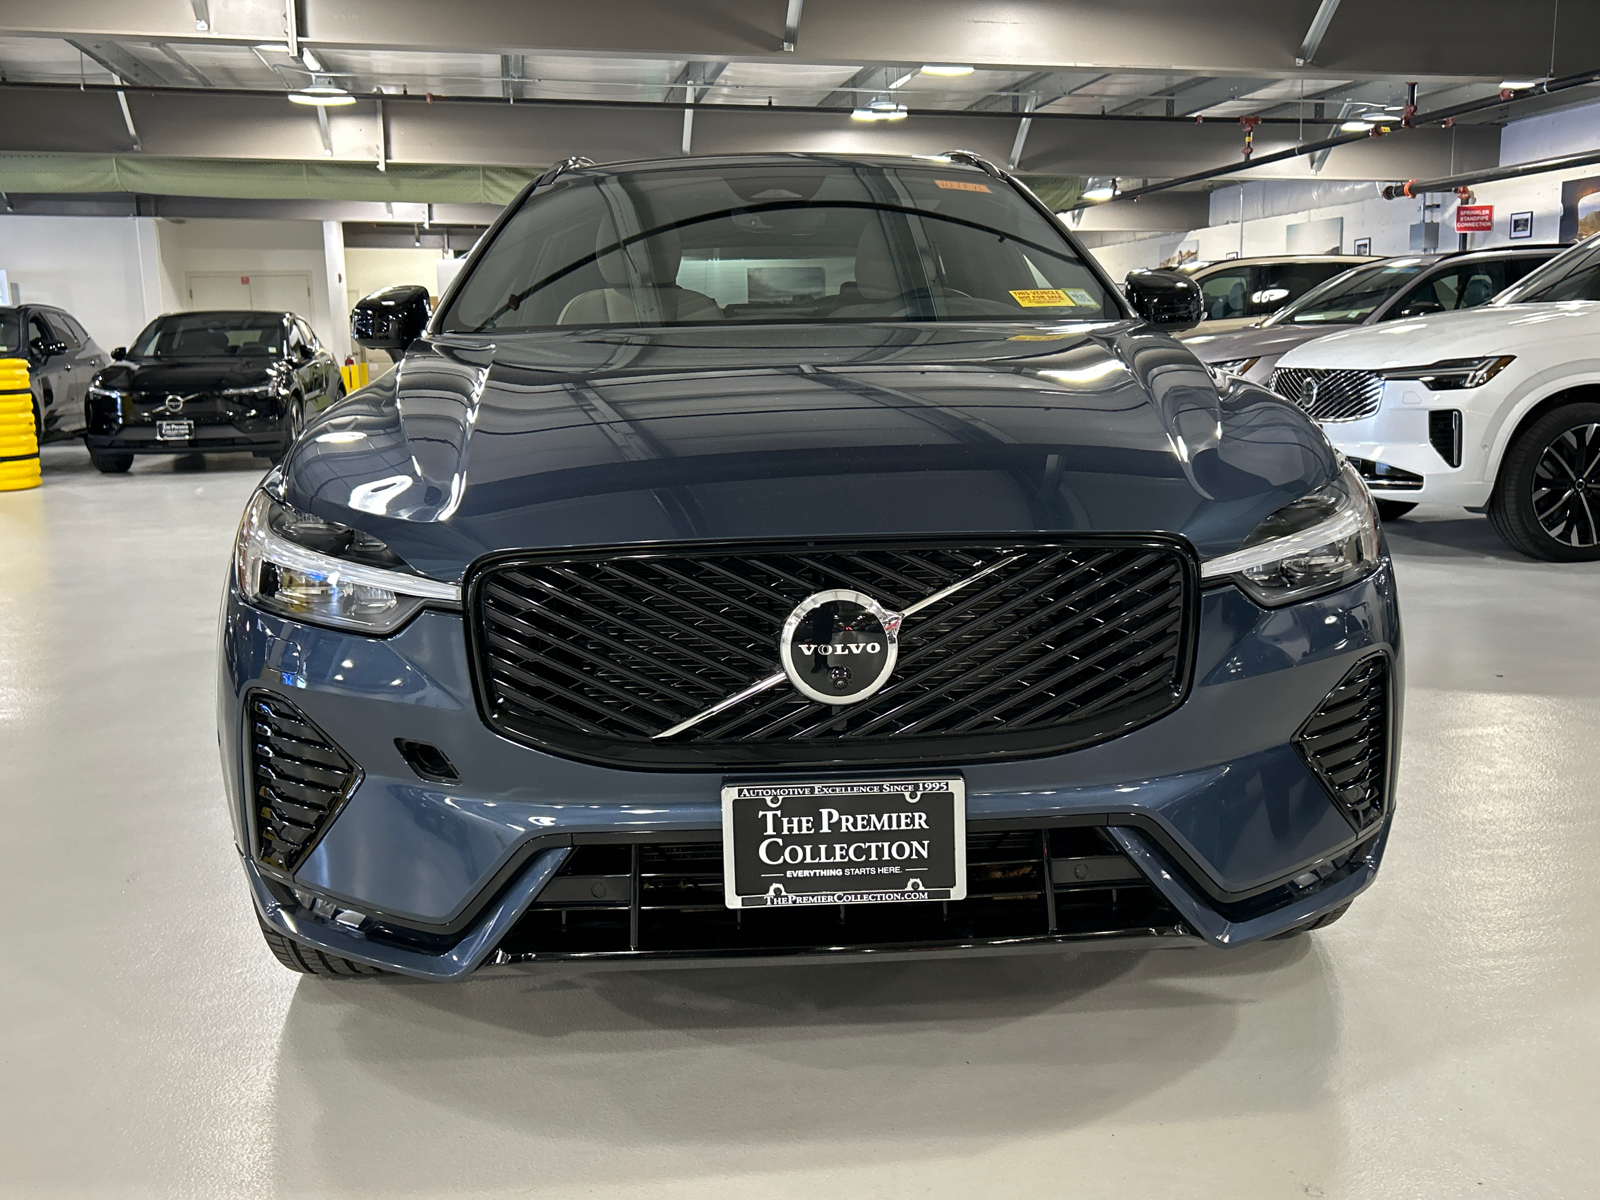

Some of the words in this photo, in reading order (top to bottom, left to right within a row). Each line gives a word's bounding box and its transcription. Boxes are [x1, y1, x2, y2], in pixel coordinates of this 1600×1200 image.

[798, 642, 881, 656] VOLVO
[740, 788, 811, 797] AUTOMOTIVE
[814, 785, 880, 794] EXCELLENCE
[882, 783, 914, 792] SINCE
[918, 782, 947, 791] 1995
[758, 809, 815, 836] THE
[819, 808, 930, 834] PREMIER
[758, 837, 930, 865] COLLECTION
[786, 868, 843, 878] EVERYTHING
[844, 867, 876, 876] STARTS
[877, 866, 903, 875] HERE.
